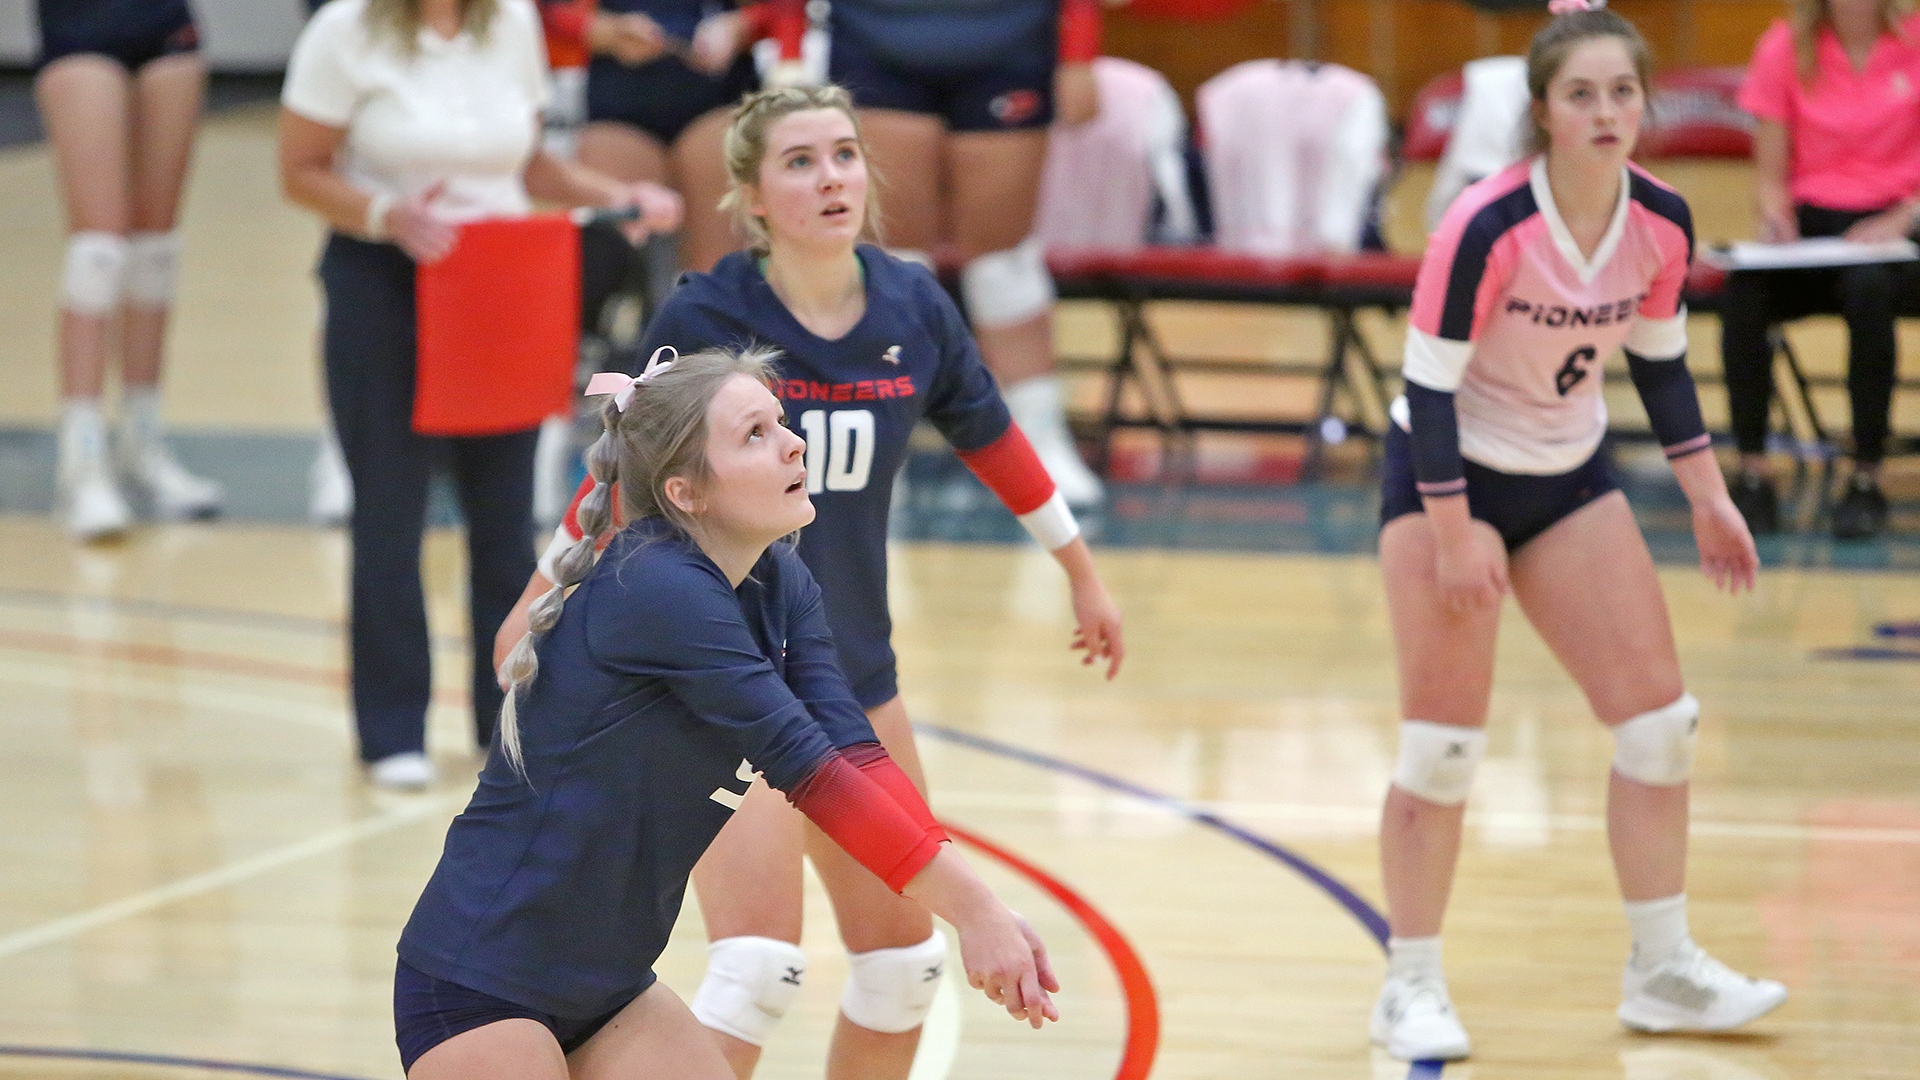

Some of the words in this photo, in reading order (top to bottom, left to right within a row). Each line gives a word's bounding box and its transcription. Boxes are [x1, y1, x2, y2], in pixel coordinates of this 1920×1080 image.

[768, 376, 915, 402] IONEERS
[1555, 344, 1597, 397] 6
[801, 409, 876, 495] 10
